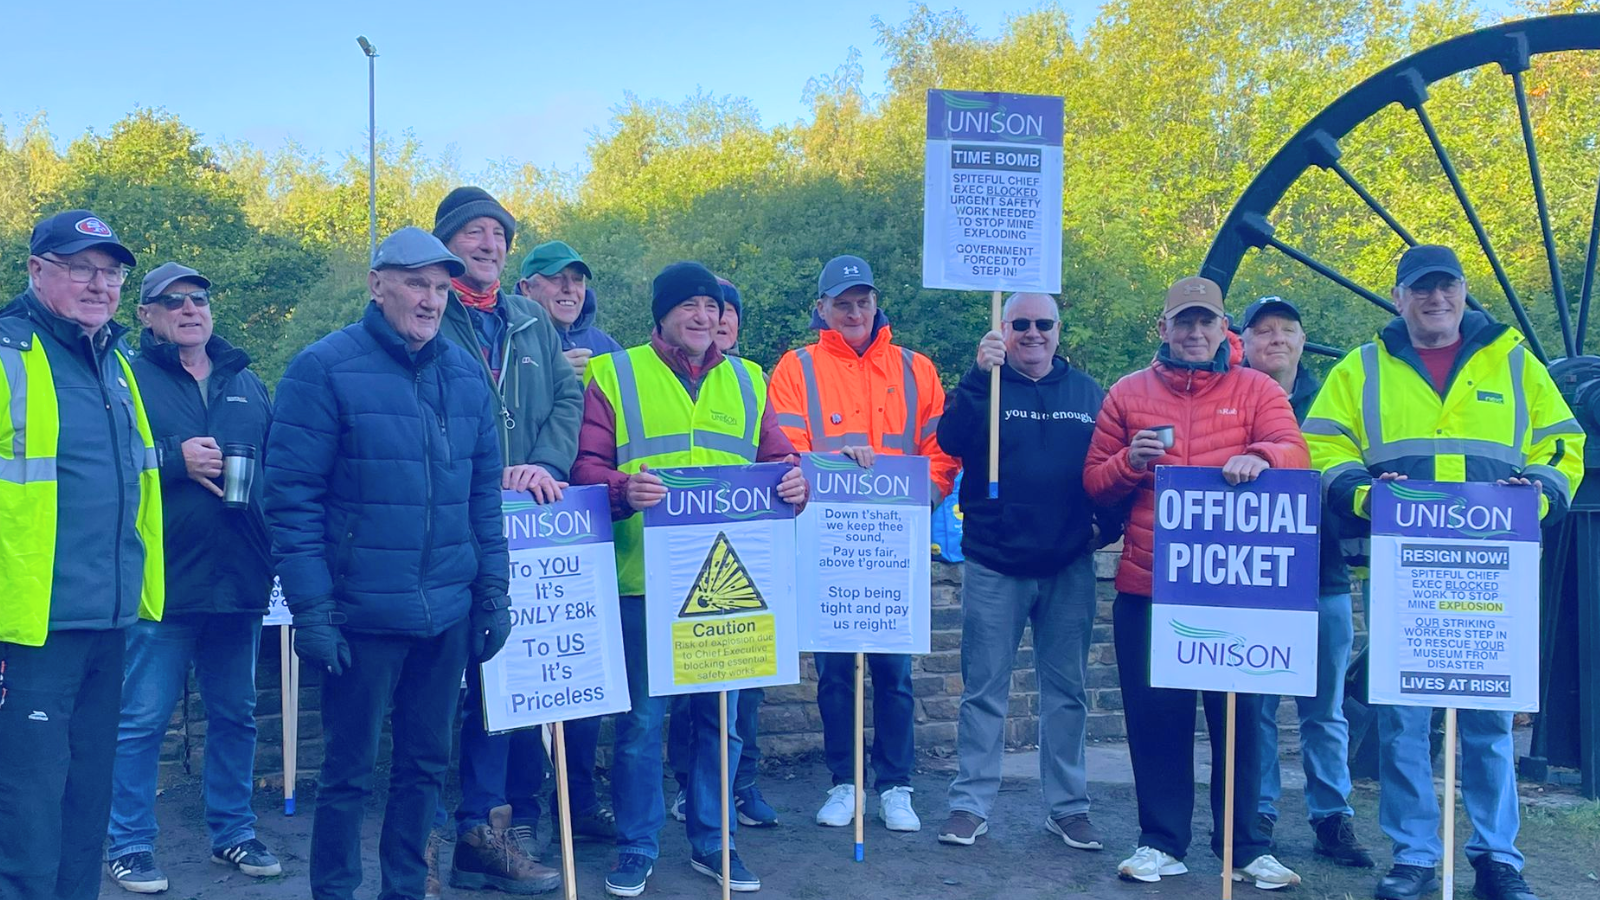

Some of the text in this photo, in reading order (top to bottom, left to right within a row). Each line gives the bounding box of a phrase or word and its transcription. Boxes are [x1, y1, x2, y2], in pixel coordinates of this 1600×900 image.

[948, 110, 1043, 136] UNISON
[953, 150, 1040, 167] TIME BOMB
[953, 174, 1039, 186] SPITEFUL CHIEF
[954, 185, 1038, 197] EXEC BLOCKED
[951, 196, 1041, 208] URGENT SAFETY
[956, 207, 1036, 218] WORK NEEDED
[957, 218, 1033, 229] TO STOP MINE
[964, 229, 1027, 240] EXPLODING
[956, 244, 1033, 256] GOVERNMENT
[964, 255, 1026, 266] FORCED TO
[972, 266, 1017, 276] STEP IN!
[1005, 409, 1027, 420] you
[816, 473, 910, 496] UNISON
[666, 486, 771, 516] UNISON
[825, 508, 858, 519] Down
[1158, 489, 1317, 535] OFFICIAL
[1396, 503, 1512, 531] UNISON
[847, 521, 875, 532] keep
[878, 522, 903, 531] thee
[845, 532, 885, 543] sound,
[833, 546, 855, 558] Pay
[875, 547, 897, 558] fair,
[1403, 549, 1508, 565] RESIGN NOW!
[510, 556, 581, 579] To YOU
[819, 558, 855, 568] above
[1168, 543, 1295, 587] PICKET
[1411, 569, 1499, 580] SPITEFUL CHIEF
[1412, 580, 1499, 591] EXEC BLOCKED
[828, 586, 901, 601] Stop being
[1413, 590, 1499, 600] WORK TO STOP
[565, 601, 596, 620] £8k
[821, 602, 909, 617] tight and pay
[1408, 600, 1503, 611] MINE EXPLOSION
[693, 621, 756, 637] Caution
[833, 618, 897, 632] us reight!
[1415, 617, 1496, 629] OUR STRIKING
[1405, 628, 1507, 640] WORKERS STEP IN
[523, 633, 585, 657] To US
[674, 641, 695, 649] Risk
[698, 640, 708, 648] of
[711, 636, 754, 647] explosion
[1407, 638, 1505, 651] TO RESCUE YOUR
[682, 645, 767, 660] to Chief Executive
[1177, 640, 1291, 669] UNISON
[1413, 649, 1498, 660] MUSEUM FROM
[684, 655, 767, 670] blocking essential
[1428, 660, 1484, 670] DISASTER
[697, 667, 756, 680] safety works
[1402, 677, 1510, 692] LIVES AT RISK!
[512, 686, 604, 713] Priceless
